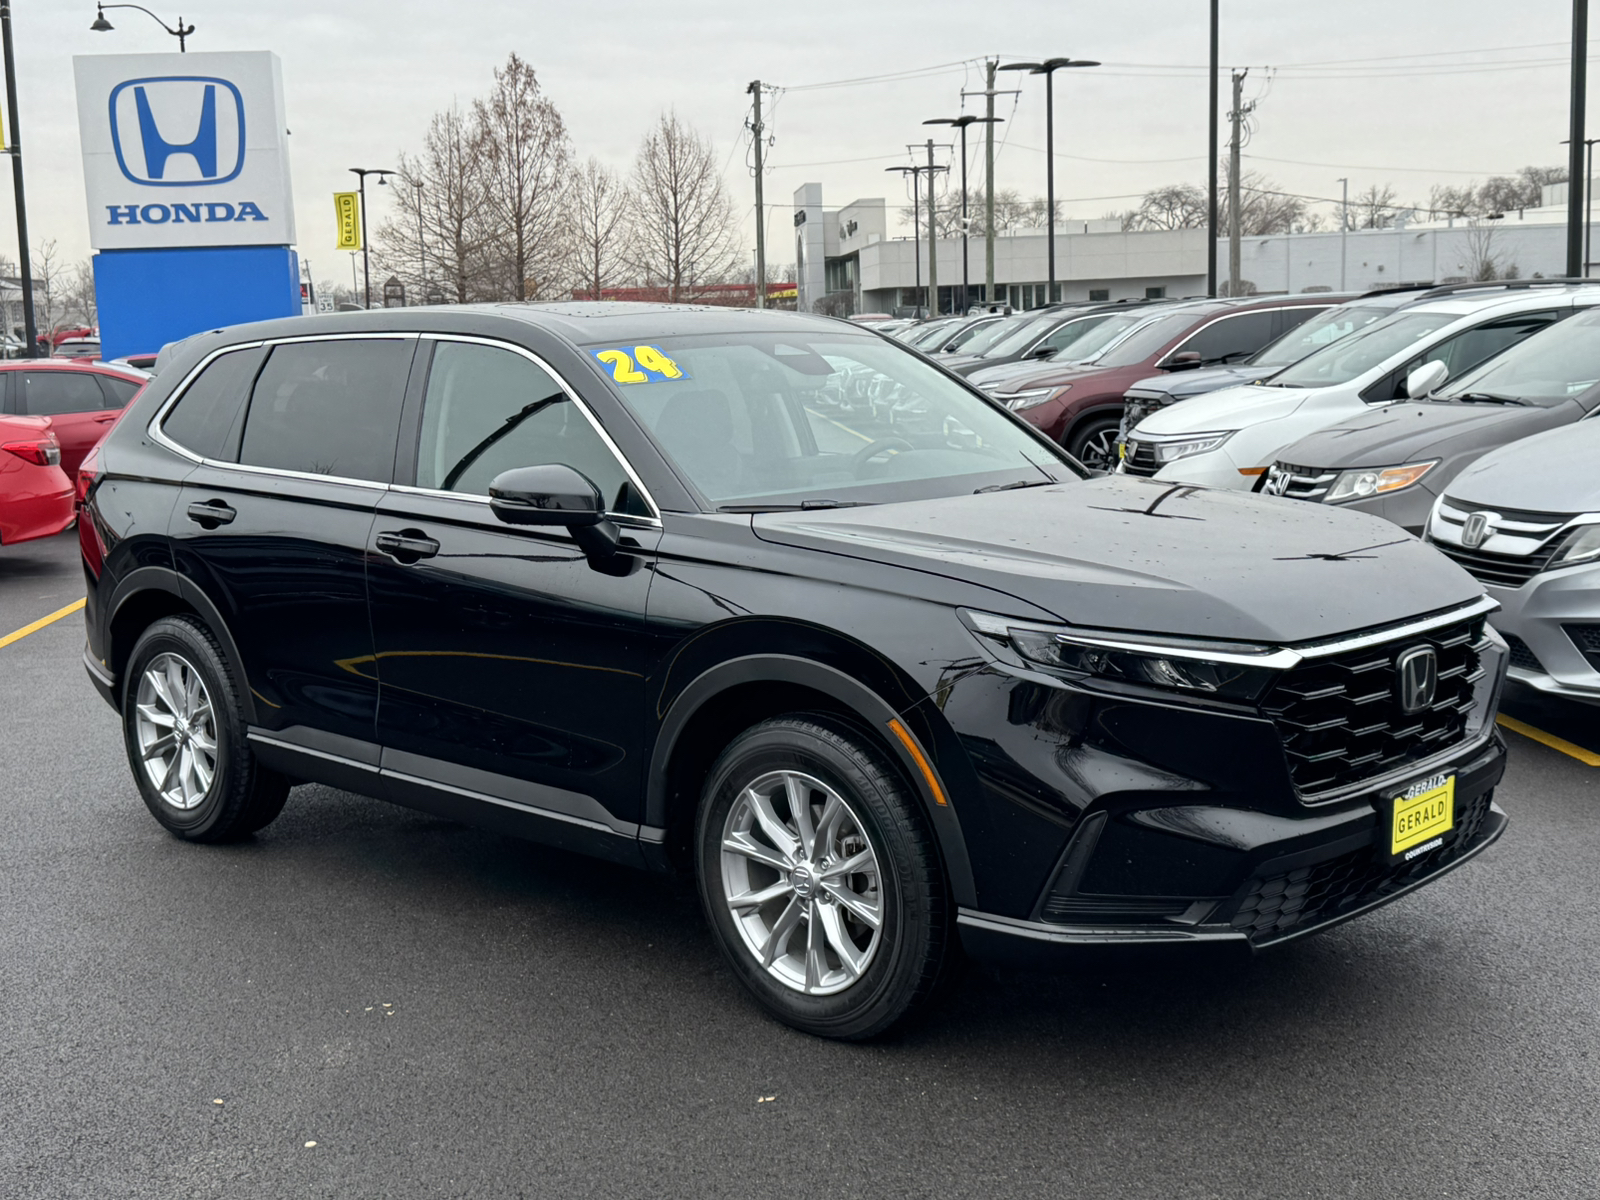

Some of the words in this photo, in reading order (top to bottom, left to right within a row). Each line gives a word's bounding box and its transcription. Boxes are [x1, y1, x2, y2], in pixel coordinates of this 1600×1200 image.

[105, 201, 269, 225] HONDA
[343, 199, 353, 243] GERALD
[320, 302, 333, 311] 35
[596, 346, 683, 384] 24
[1408, 775, 1445, 799] GERALD
[1398, 801, 1444, 834] GERALD
